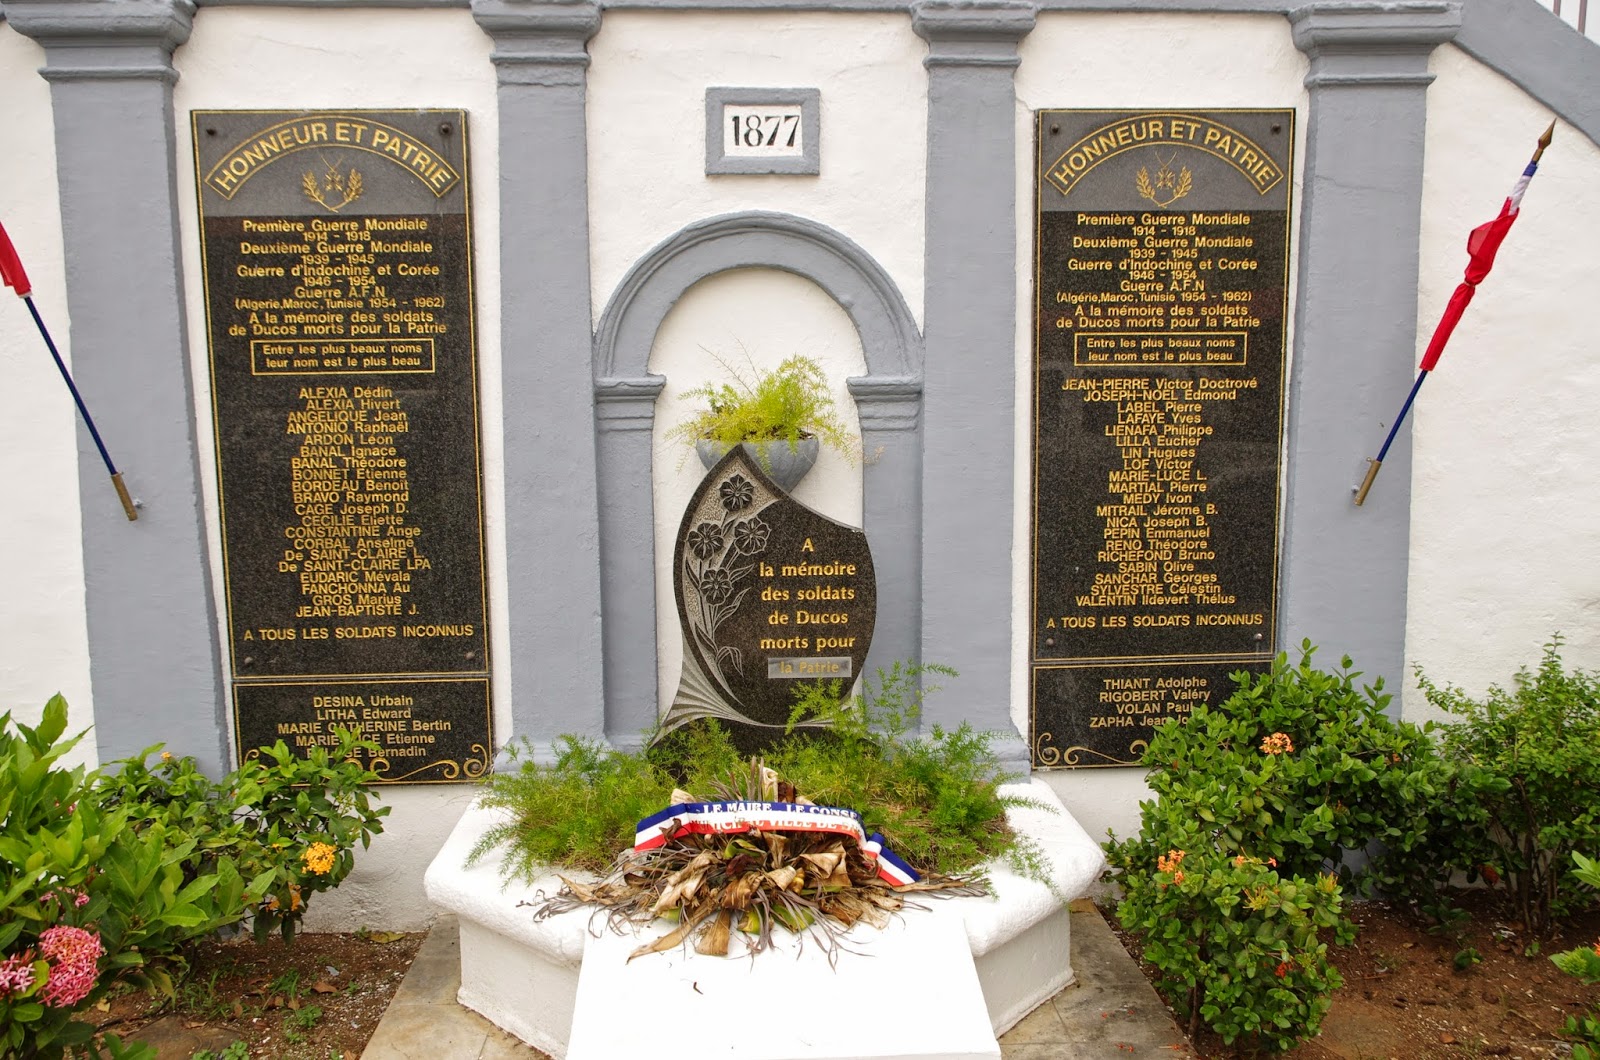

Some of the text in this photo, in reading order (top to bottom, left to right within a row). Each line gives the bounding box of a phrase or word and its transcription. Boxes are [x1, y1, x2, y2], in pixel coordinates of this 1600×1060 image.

[732, 115, 799, 147] 1877
[214, 122, 451, 191] HONNEUR ET PATRIE
[1054, 121, 1275, 186] HONNEUR ET PATRIE
[243, 219, 427, 232] Première Guerre Mondiale
[303, 231, 371, 241] 1914 1918
[241, 241, 432, 255] Deuxième Guerre Mondiale
[302, 255, 374, 265] 1939 1945
[237, 264, 439, 277] Guerre d'Indochine et Corée
[1087, 338, 1235, 348] Entre les plus beaux noms
[1089, 352, 1109, 361] leur
[1142, 352, 1160, 360] est
[1165, 352, 1174, 360] le
[1179, 351, 1201, 361] plus
[1207, 351, 1232, 360] beau
[1062, 377, 1257, 390] JEAN-PIERRE Victor Doctrové
[299, 387, 392, 399] ALEXIA Dédin
[1084, 389, 1236, 401] JOSEPH-NOEL Edmond
[306, 399, 400, 410] ALEXIA Hivert
[1117, 402, 1202, 412] LABEL Pierre
[287, 411, 407, 422] ANGELIQUE Jean
[1118, 413, 1201, 424] LAFAYE Yves
[287, 421, 408, 434] ANTONIO Raphaël
[1164, 425, 1213, 436] Philippe
[304, 433, 393, 445] ARDON Léon
[1116, 436, 1201, 446] LILLA Eucher
[301, 446, 396, 458] BANAL Ignace
[1122, 448, 1195, 459] LIN Hugues
[292, 456, 406, 469] BANAL Théodore
[1124, 459, 1192, 470] LOF Victor
[293, 468, 407, 480] BONNET Etienne
[1109, 470, 1207, 481] MARIE-LUCE L.
[292, 480, 359, 492] BORDEAU
[1109, 482, 1207, 493] MARTIAL Pierre
[294, 492, 408, 504] BRAVO Raymond
[1124, 493, 1192, 503] MEDY Ivon
[295, 502, 409, 515] CAGE Joseph D.
[1097, 505, 1147, 516] MITRAIL
[1207, 504, 1218, 515] B.
[302, 515, 354, 527] CECILIE
[1107, 516, 1208, 527] NICA Joseph B.
[285, 526, 421, 538] CONSTANTINE Ange
[1104, 527, 1210, 539] PEPIN Emmanuel
[294, 537, 414, 550] CORBAL Anselme
[802, 538, 814, 552] A
[1106, 539, 1207, 551] RENO Théodore
[285, 548, 424, 561] De SAINT-CLAIRE L.
[1098, 550, 1215, 562] RICHEFOND Bruno
[760, 561, 856, 576] la mémoire
[1119, 562, 1194, 572] SABIN Olive
[1095, 574, 1217, 585] SANCHAR Georges
[302, 583, 387, 594] FANCHONNA
[761, 586, 855, 601] des soldats
[1091, 584, 1221, 596] SYLVESTRE Célestin
[313, 594, 401, 605] GROS Marius
[1076, 595, 1135, 606] VALENTIN
[1196, 594, 1235, 604] Thélus
[296, 604, 419, 618] JEAN-BAPTISTE J.
[768, 611, 848, 625] de Ducos
[244, 625, 474, 641] A TOUS LES SOLDATS INCONNUS
[760, 637, 855, 651] morts pour
[780, 662, 839, 673] la Patrie
[1104, 677, 1207, 690] THIANT Adolphe
[313, 695, 413, 708] DESINA Urbain
[1100, 690, 1211, 702] RIGOBERT Valéry
[317, 709, 411, 720] LITHA Edward
[1116, 703, 1161, 714] VOLAN
[278, 720, 451, 734] MARIE CATHERINE Bertin
[1090, 717, 1134, 728] ZAPHA
[387, 733, 435, 744] Etienne
[703, 803, 805, 813] LE MAIRE LE
